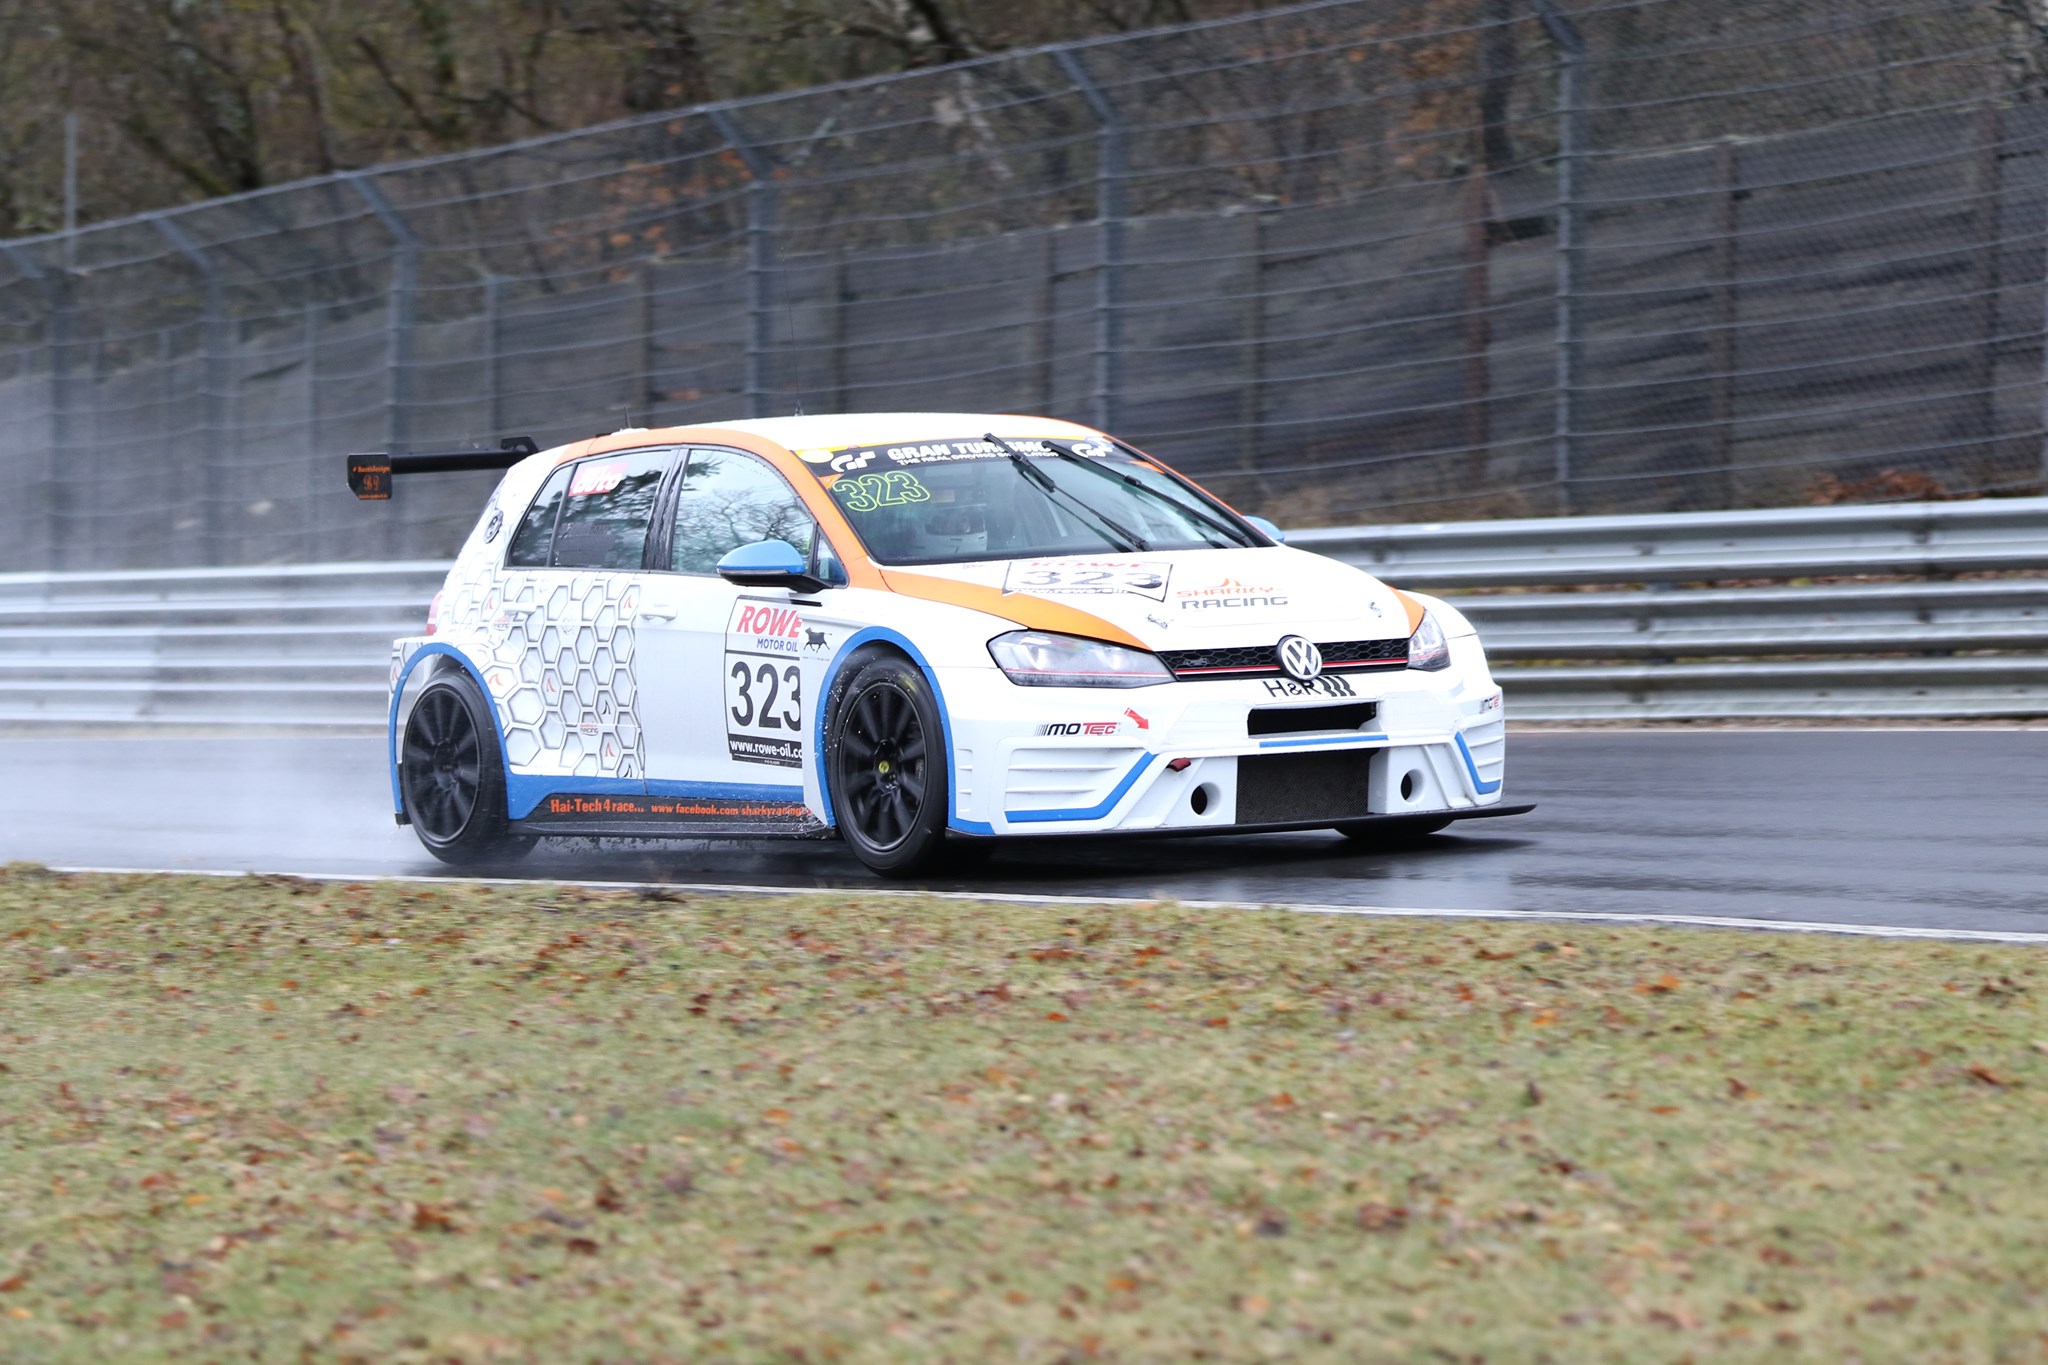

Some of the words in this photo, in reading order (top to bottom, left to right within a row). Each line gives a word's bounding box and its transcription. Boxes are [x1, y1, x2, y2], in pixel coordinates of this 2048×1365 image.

[887, 443, 951, 461] GRAN
[832, 470, 931, 512] 323
[1019, 570, 1163, 590] 323
[1181, 596, 1289, 610] RACING
[736, 605, 802, 639] ROWE
[756, 637, 785, 651] MOTOR
[785, 640, 799, 653] OIL
[731, 661, 802, 732] 323
[1262, 679, 1322, 698] H&R
[602, 798, 612, 812] 4
[611, 801, 645, 813] race...
